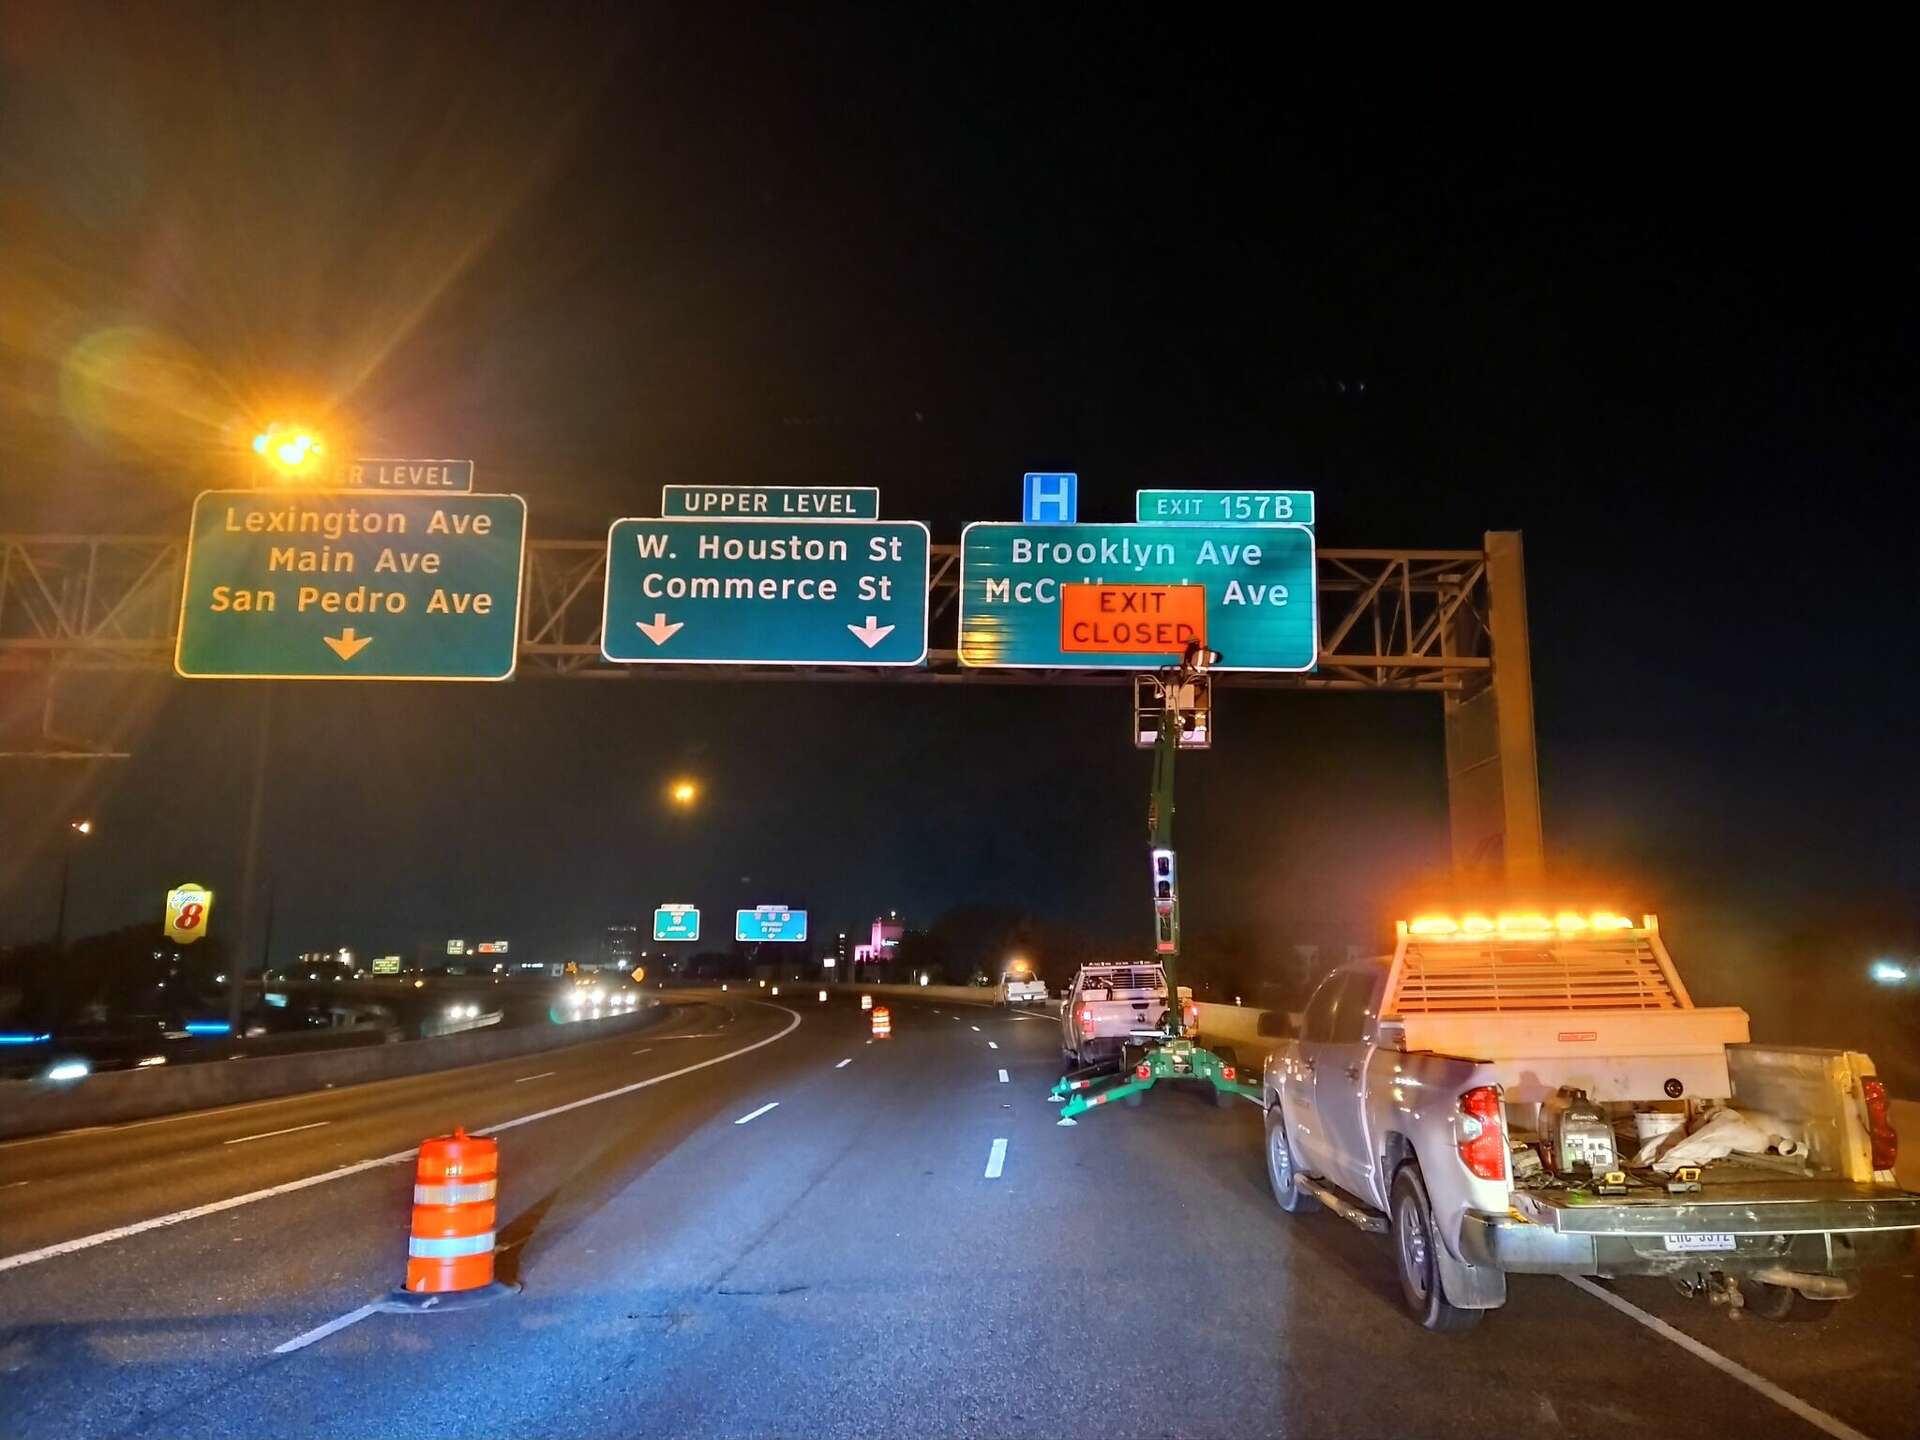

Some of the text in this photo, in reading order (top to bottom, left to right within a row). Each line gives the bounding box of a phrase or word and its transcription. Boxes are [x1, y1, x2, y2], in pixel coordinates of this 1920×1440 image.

[378, 466, 454, 486] LEVEL
[684, 493, 857, 514] UPPER LEVEL
[1032, 477, 1069, 521] H
[1156, 496, 1294, 520] EXIT 157B
[225, 506, 491, 540] Lexington Ave
[268, 547, 441, 574] Main Ave
[636, 534, 903, 562] W. Houston St
[1011, 538, 1263, 572] Brooklyn Ave
[210, 586, 492, 615] San Pedro Ave
[642, 573, 892, 601] Commerce St
[1222, 580, 1289, 607] Ave
[1100, 592, 1166, 613] EXIT
[1073, 622, 1195, 644] CLOSED
[174, 903, 203, 930] 8
